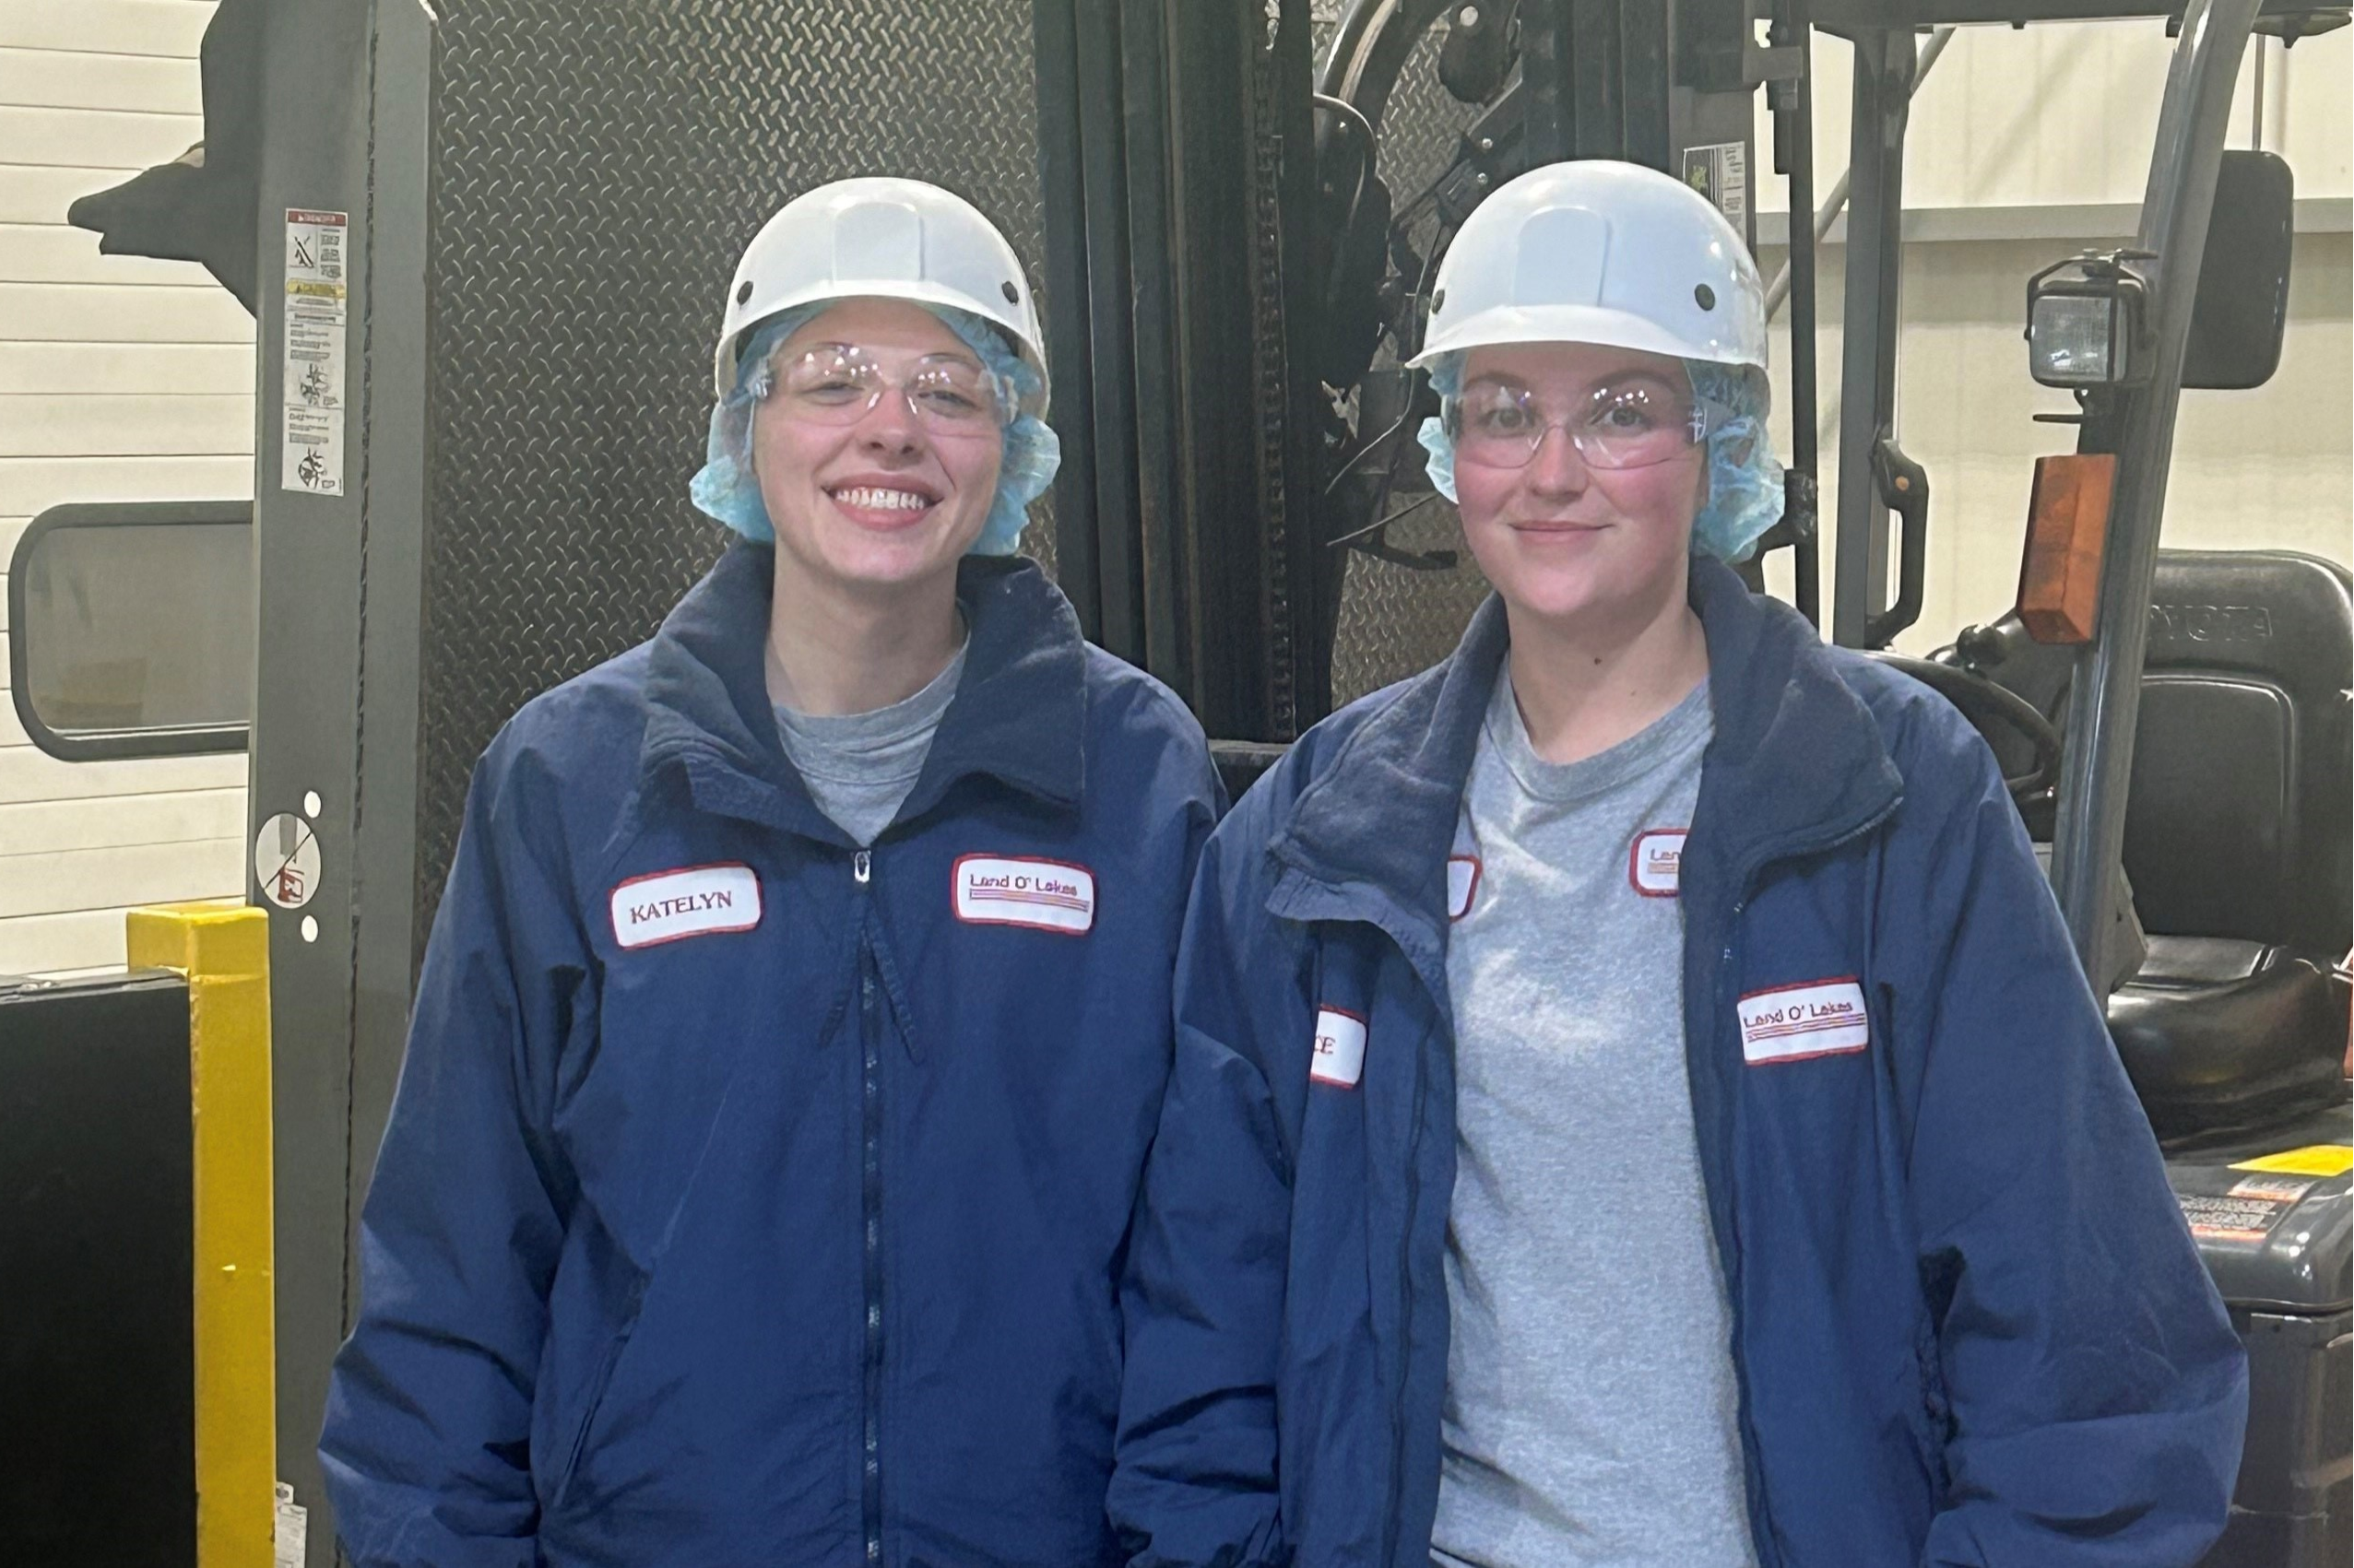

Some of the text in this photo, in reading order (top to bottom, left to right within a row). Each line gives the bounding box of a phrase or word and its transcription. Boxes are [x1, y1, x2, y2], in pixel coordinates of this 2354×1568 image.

[970, 874, 1010, 888] Land
[1035, 878, 1078, 897] Lakes
[630, 890, 732, 925] KATELYN
[1744, 1009, 1784, 1028] Land
[1809, 1001, 1853, 1018] Lakes
